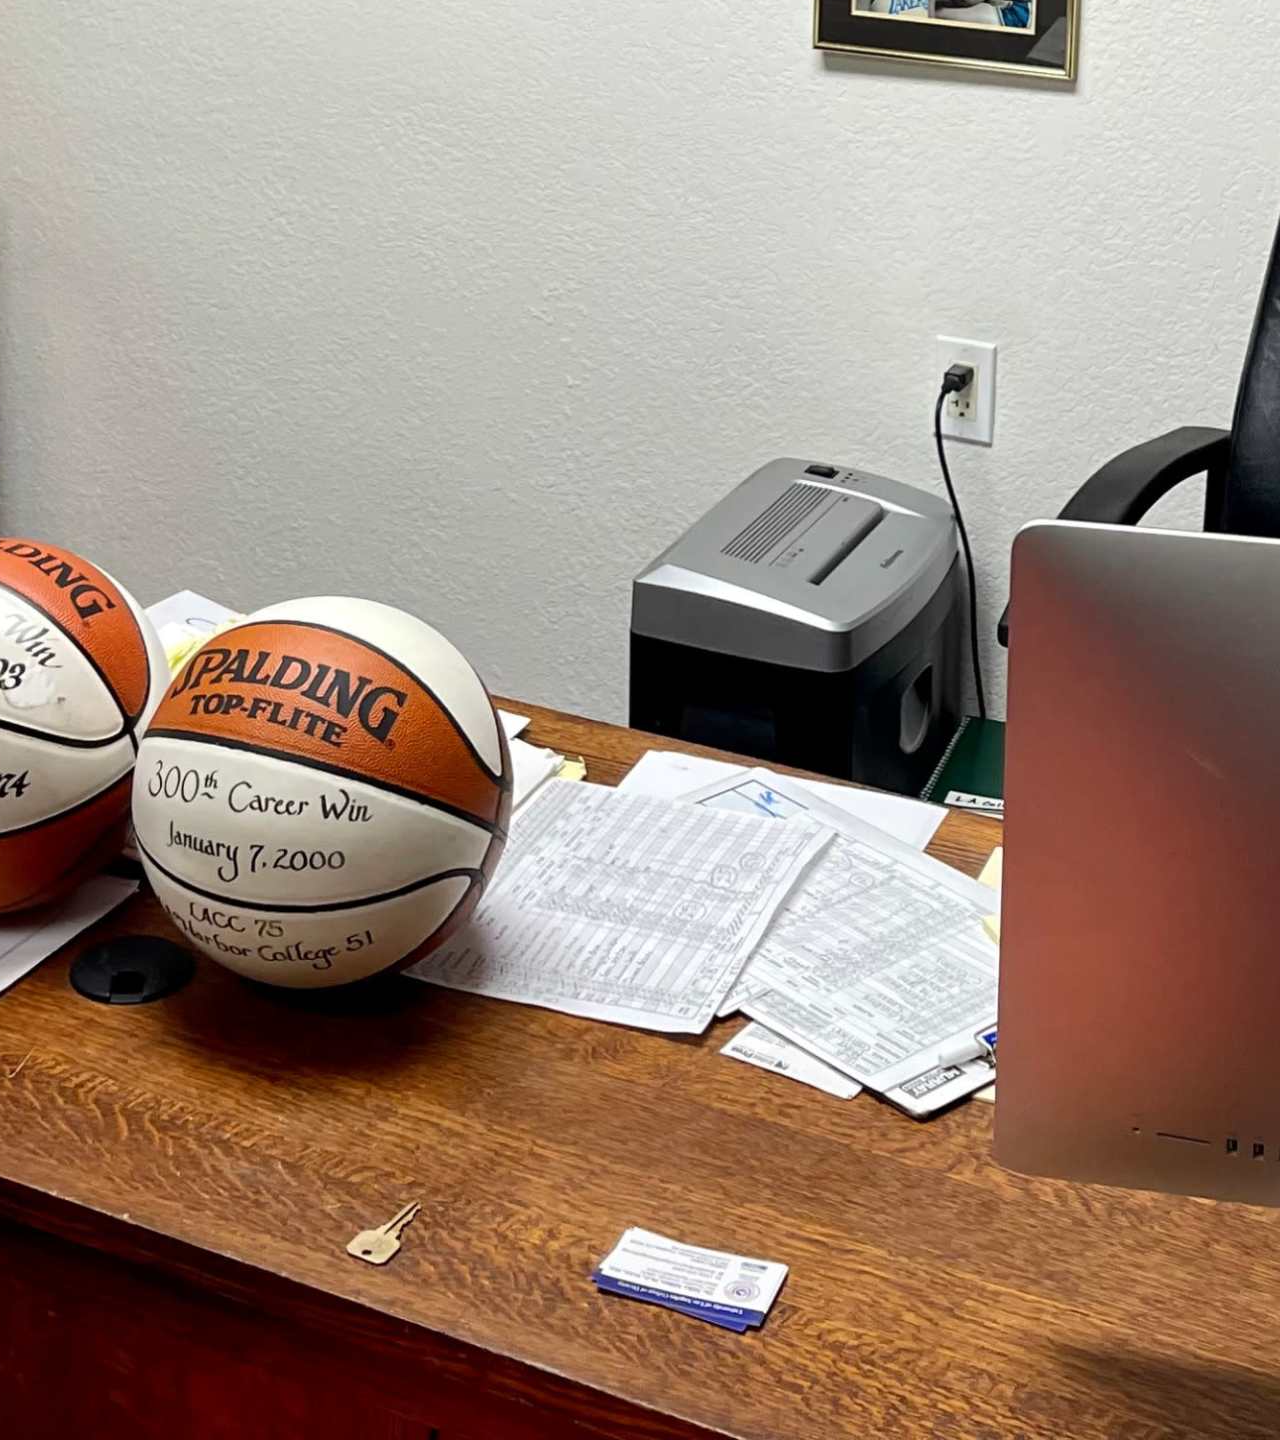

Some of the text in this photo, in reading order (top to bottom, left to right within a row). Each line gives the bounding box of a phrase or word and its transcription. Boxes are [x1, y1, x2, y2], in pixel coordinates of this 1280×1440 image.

[4, 611, 62, 669] Win
[171, 648, 408, 741] SPALDING
[190, 694, 347, 748] TOP-FLITE
[148, 760, 373, 823] 300th Career Win
[168, 821, 238, 882] January
[274, 848, 346, 871] 2000
[255, 920, 284, 937] 75
[258, 941, 342, 970] College
[347, 930, 374, 951] 51
